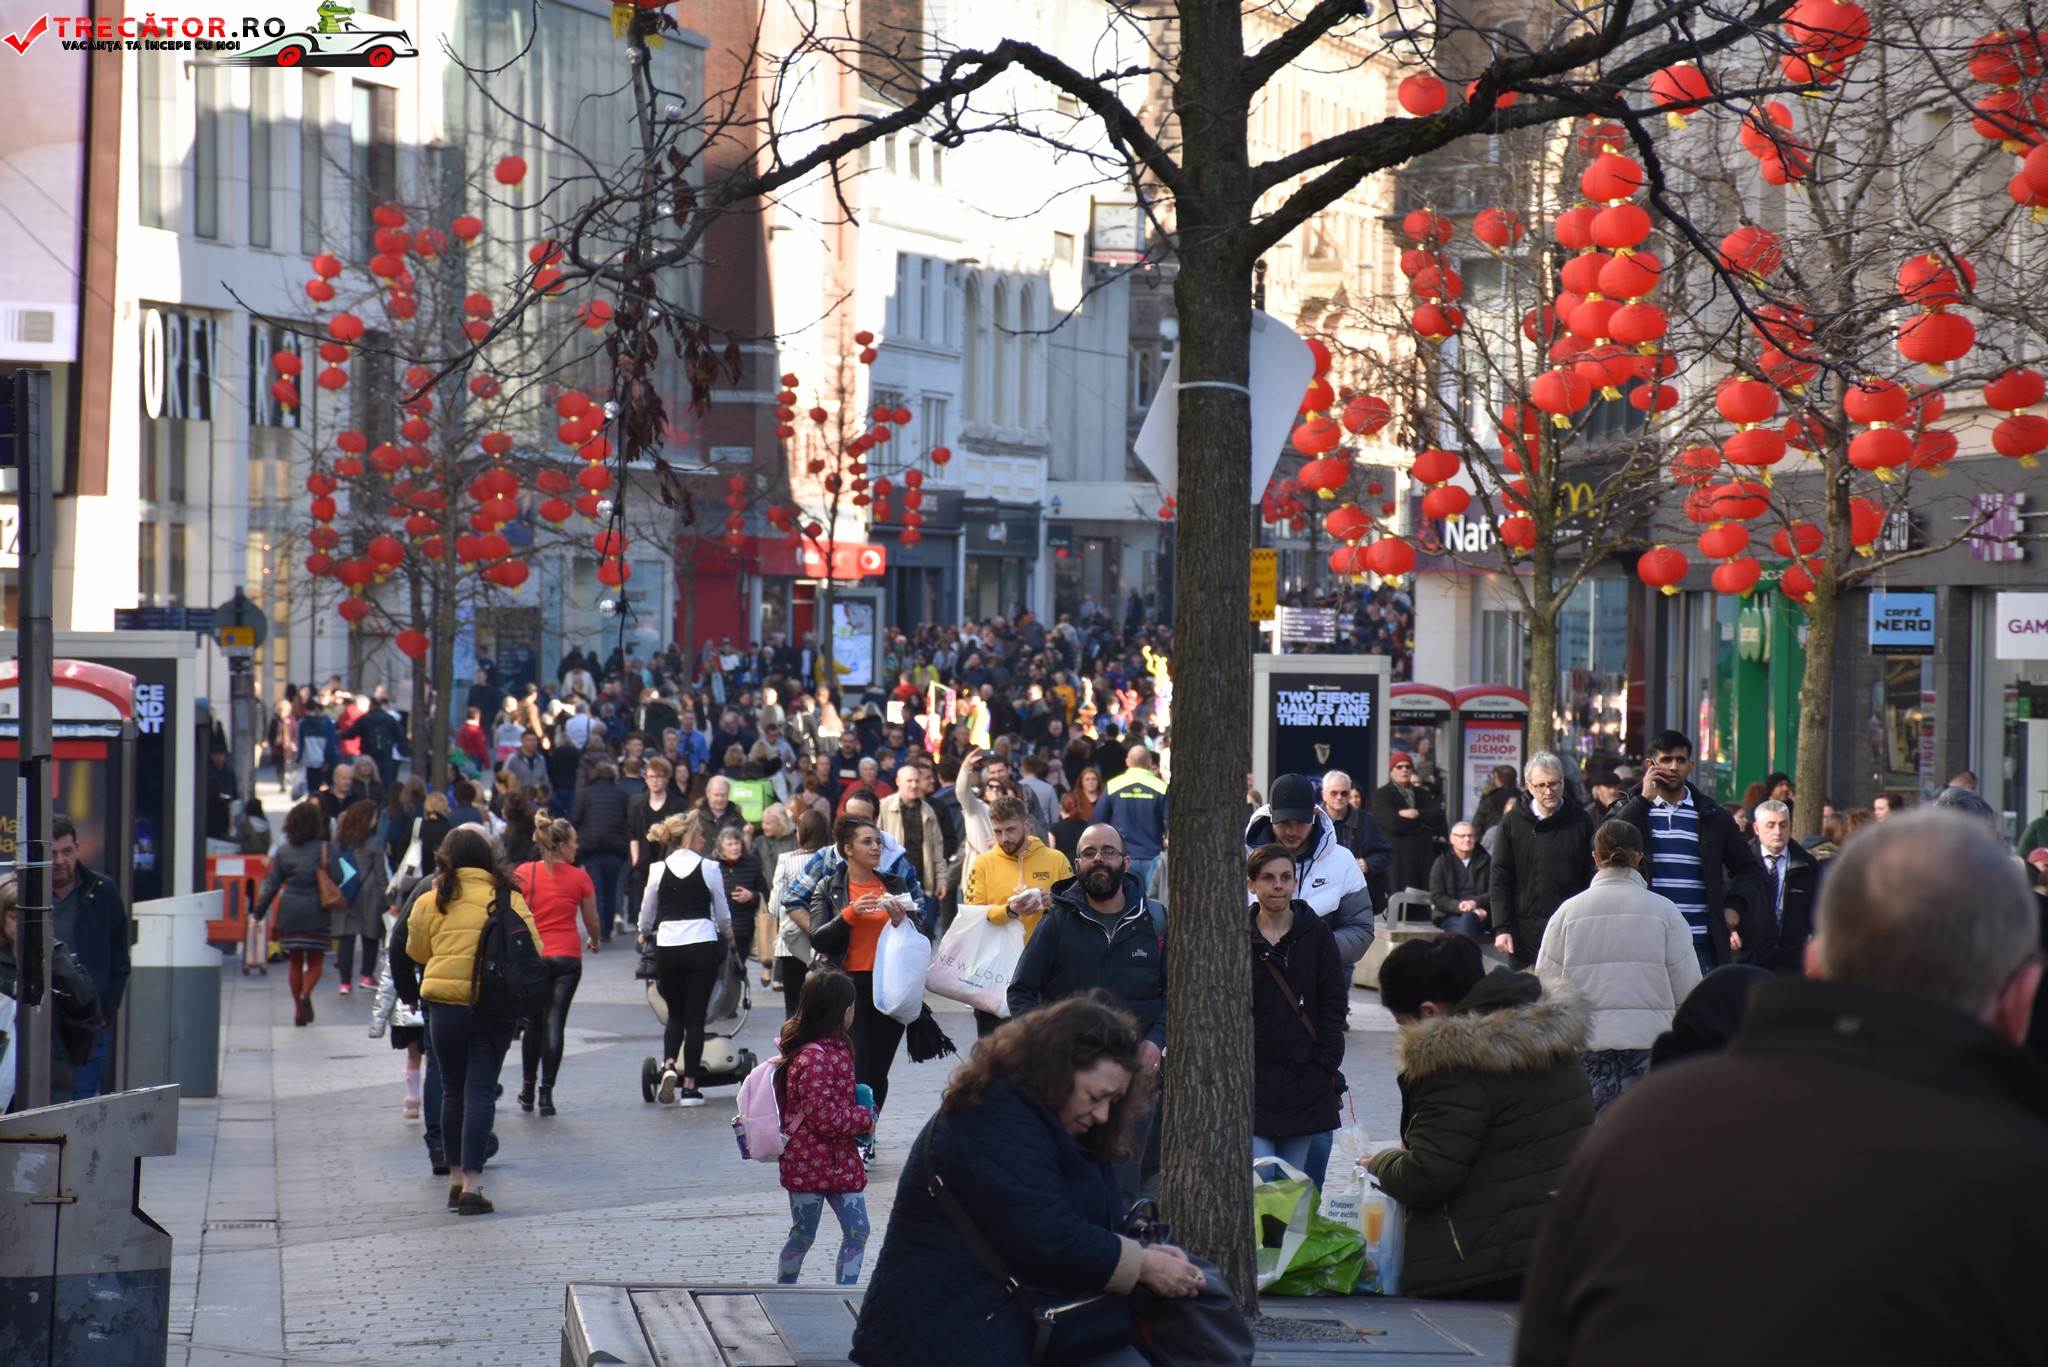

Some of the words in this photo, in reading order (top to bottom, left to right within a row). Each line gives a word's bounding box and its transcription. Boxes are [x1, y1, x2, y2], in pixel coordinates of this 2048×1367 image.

[1875, 619, 1932, 632] NERO
[1277, 691, 1315, 704] TWO
[1317, 692, 1371, 704] FIERCE
[1277, 703, 1335, 716] HALVES
[1337, 704, 1371, 716] AND
[1277, 714, 1319, 726] THEN
[1320, 715, 1333, 726] A
[1335, 716, 1371, 727] PINT
[1476, 733, 1510, 743] JOHN
[1469, 745, 1516, 754] BISHOP
